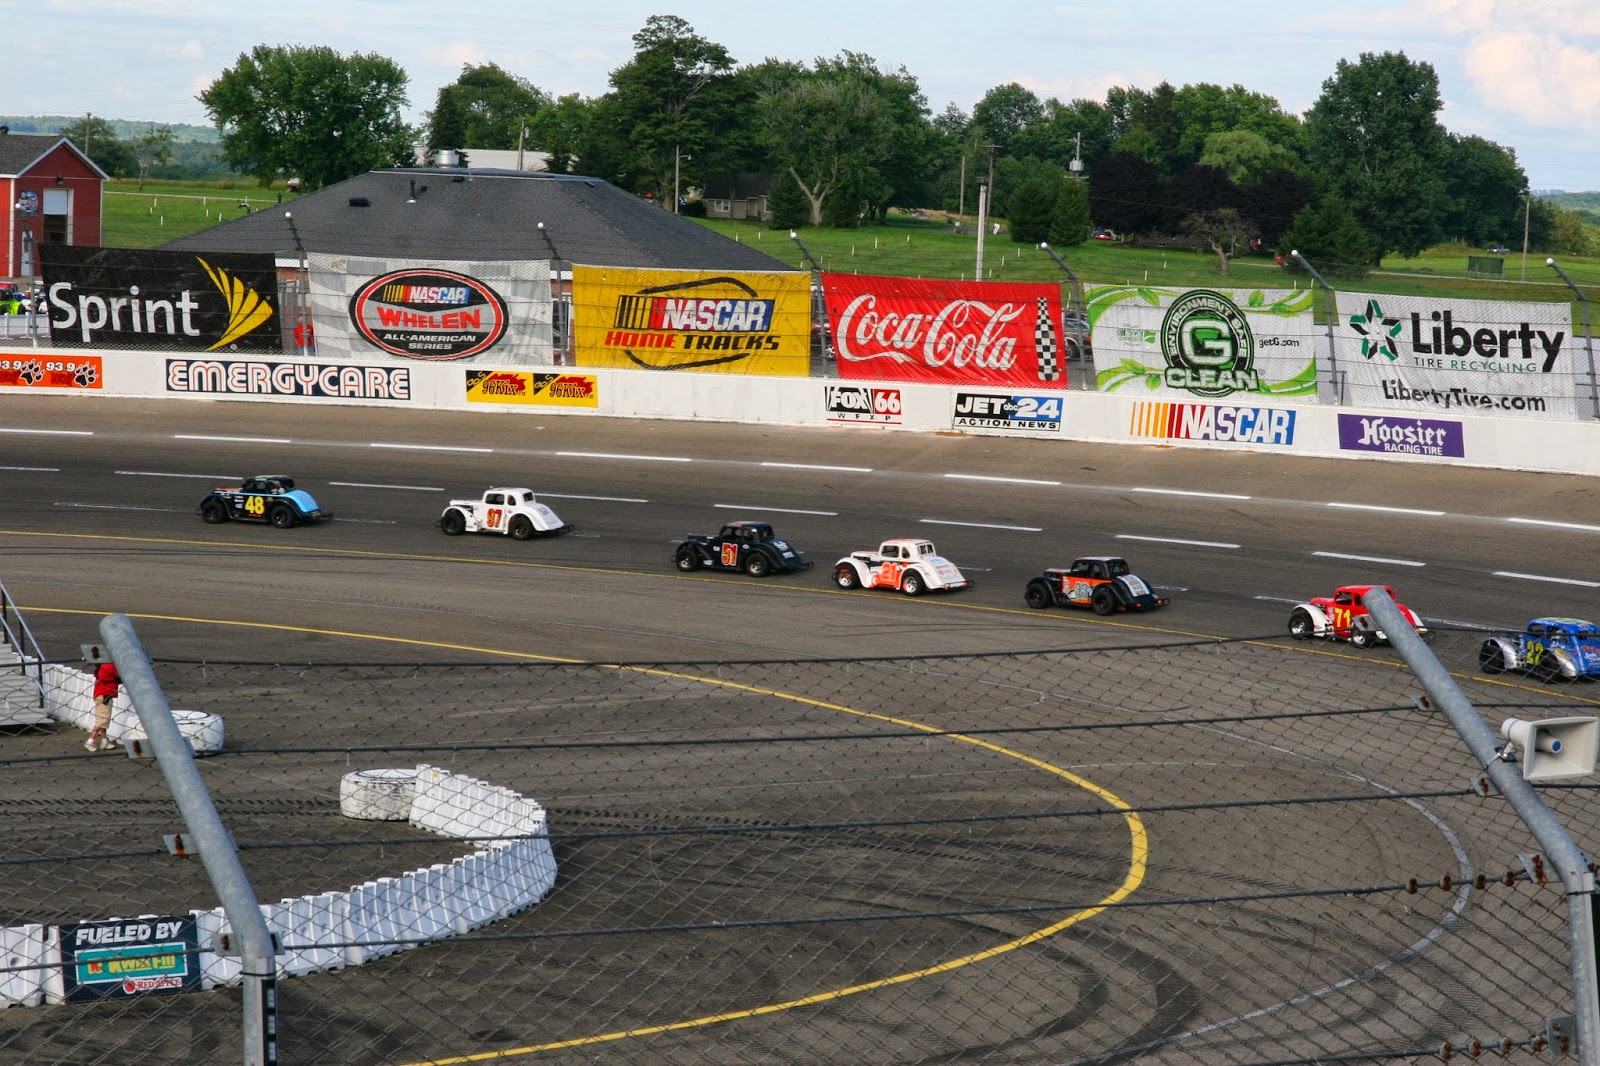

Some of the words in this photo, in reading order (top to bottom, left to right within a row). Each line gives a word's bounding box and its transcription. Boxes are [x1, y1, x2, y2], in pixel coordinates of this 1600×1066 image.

[409, 286, 470, 304] NASCAR
[49, 281, 200, 343] Sprint
[376, 306, 481, 329] WHELEN
[661, 298, 769, 332] NASCAR
[383, 332, 476, 343] ALL-AMERICAN
[836, 294, 1026, 371] Coca-Cola
[1168, 297, 1233, 357] ENVIRONMENT
[1231, 318, 1248, 358] SAFE
[408, 342, 452, 350] SERIES
[604, 331, 679, 349] HOME
[682, 334, 781, 350] TRACKS
[1182, 319, 1232, 365] G
[1411, 311, 1565, 373] Liberty
[46, 362, 76, 372] 93.9
[1414, 357, 1443, 369] TIRE
[1450, 360, 1537, 373] RECYCLING
[168, 361, 409, 399] EMERGYCARE
[1165, 367, 1259, 391] CLEAN
[829, 391, 868, 411] FOX
[874, 391, 901, 414] 66
[1382, 379, 1546, 412] LibertyTire.com
[957, 396, 1004, 415] JET
[1003, 403, 1019, 412] abc
[1016, 398, 1060, 419] 24
[958, 418, 1012, 427] ACTION
[1018, 421, 1058, 429] NEWS
[1180, 403, 1290, 444] NASCAR
[1358, 418, 1447, 446] Hoosier
[1384, 443, 1421, 454] RACING
[1422, 446, 1443, 455] TIRE
[245, 496, 265, 514] 48
[722, 543, 738, 565] 51
[1335, 607, 1351, 628] 71
[76, 924, 151, 945] FUELED
[155, 921, 182, 939] BY
[137, 981, 156, 989] RED
